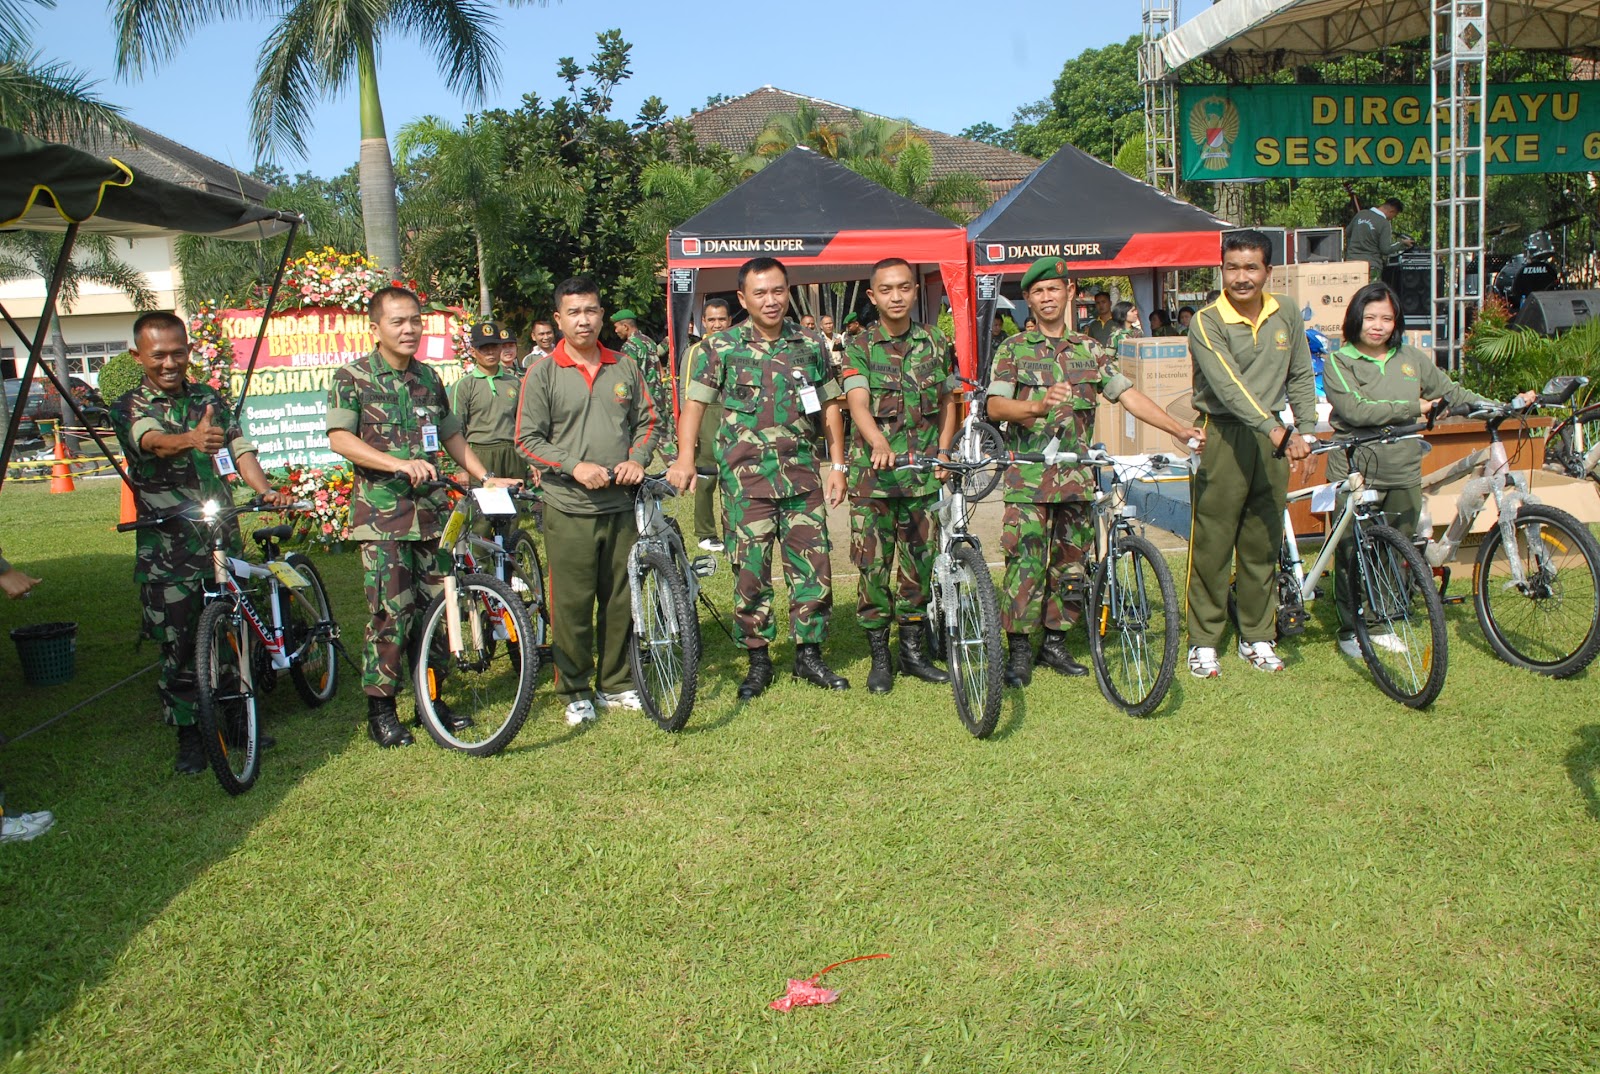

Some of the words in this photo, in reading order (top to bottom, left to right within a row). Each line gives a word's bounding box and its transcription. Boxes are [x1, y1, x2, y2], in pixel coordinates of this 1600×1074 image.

[1484, 134, 1540, 163] KE
[704, 239, 760, 253] DJARUM
[764, 239, 804, 252] SUPER
[1008, 244, 1060, 258] DJARUM
[1063, 243, 1101, 256] SUPER
[269, 333, 338, 357] BESERTA
[344, 332, 379, 353] STA
[246, 406, 285, 420] Semoga
[285, 402, 316, 416] Tuhan
[249, 422, 279, 436] Selalu
[285, 437, 305, 450] Dan
